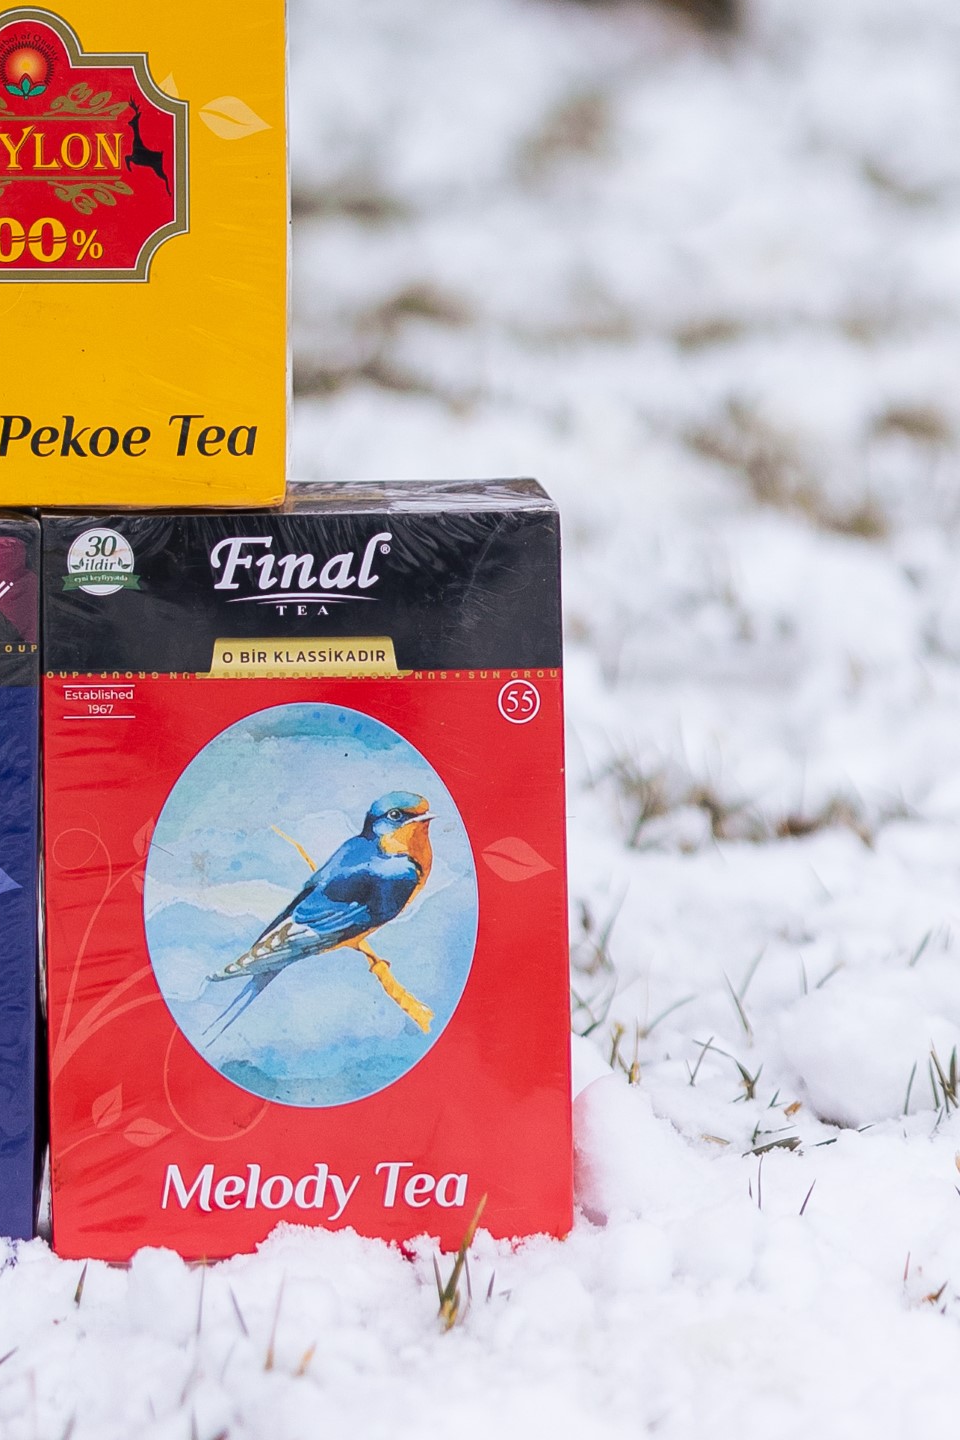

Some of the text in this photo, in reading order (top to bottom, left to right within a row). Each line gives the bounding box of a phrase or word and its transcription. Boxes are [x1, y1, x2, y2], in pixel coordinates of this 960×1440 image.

[168, 415, 258, 458] Tea
[85, 536, 117, 557] 30
[85, 559, 116, 570] ildir
[276, 605, 329, 616] TEA
[222, 647, 386, 664] O BİR KLASSİKADIR
[469, 670, 500, 679] SUN
[65, 689, 134, 700] Established
[506, 690, 534, 713] 55
[87, 704, 114, 714] 1967
[161, 1162, 469, 1221] Melody Tea
